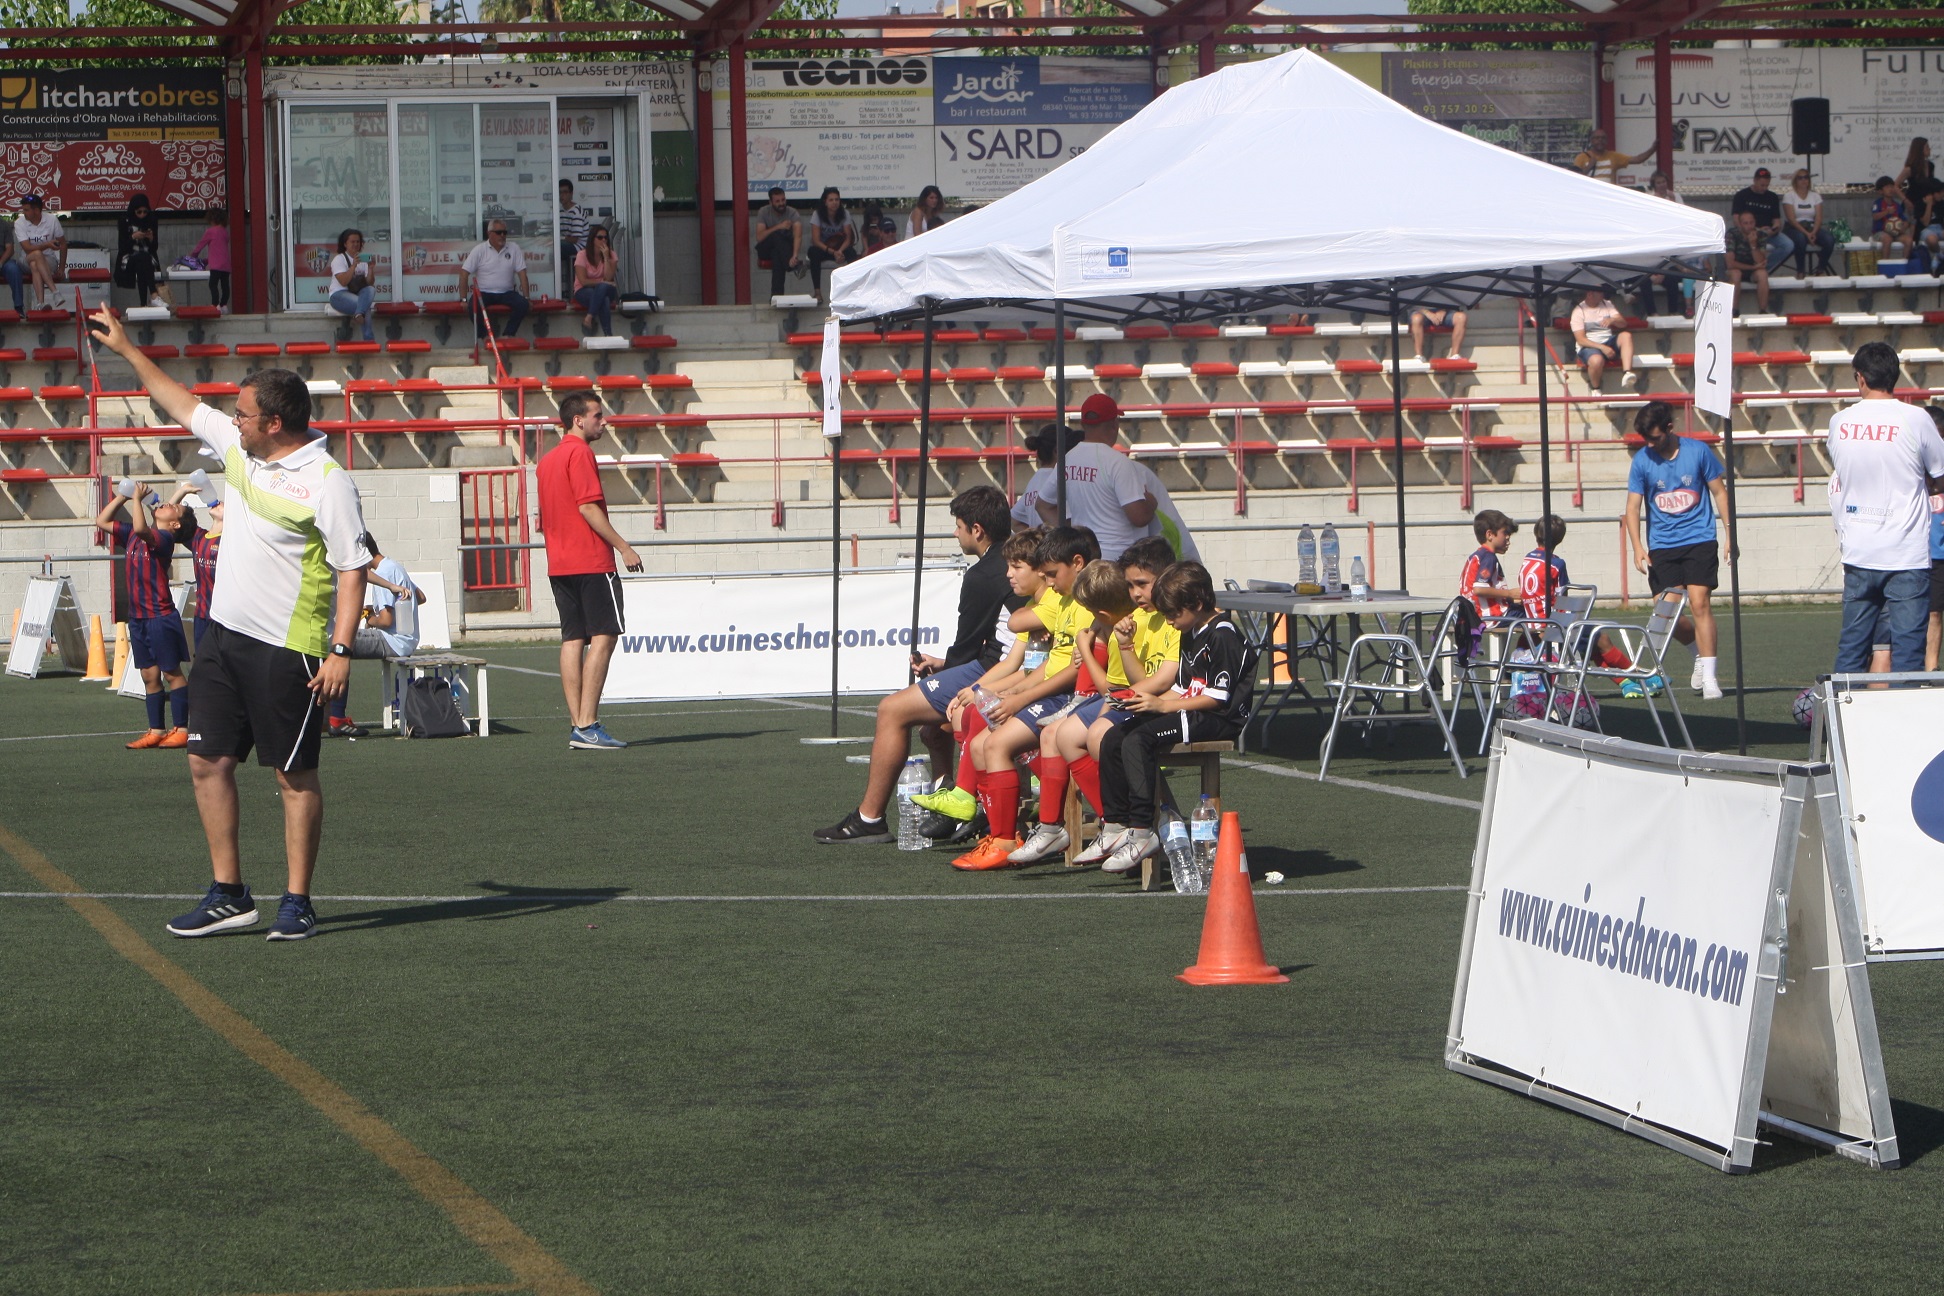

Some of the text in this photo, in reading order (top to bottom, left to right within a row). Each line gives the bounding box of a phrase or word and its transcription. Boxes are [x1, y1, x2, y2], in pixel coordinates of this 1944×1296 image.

[533, 66, 685, 76] TOTA CLASSE DE TREBALLS
[716, 74, 766, 88] esola
[1411, 73, 1463, 89] Energia
[1467, 72, 1505, 85] Solar
[43, 83, 219, 108] itchartobres
[650, 94, 686, 105] ARREC
[745, 90, 917, 98] cnos@hotmail.com www.autoescuela-tecnos.com
[950, 107, 967, 117] bar
[976, 107, 1027, 116] restaurant
[1423, 105, 1436, 114] 93
[1441, 105, 1460, 114] 757
[1464, 104, 1478, 114] 30
[1482, 104, 1495, 114] 25
[2, 114, 70, 124] Construccions
[72, 114, 106, 124] d'Obra
[110, 114, 135, 122] Nova
[144, 112, 220, 122] Rehabilitacions.
[1899, 117, 1944, 125] VETERIN
[538, 118, 549, 136] DE
[1461, 122, 1520, 144] Muguet
[860, 132, 871, 140] Tot
[872, 132, 886, 140] per
[887, 132, 894, 140] al
[785, 155, 808, 178] bu
[28, 234, 50, 242] HKT
[524, 252, 546, 261] Mar
[1702, 298, 1722, 314] CAMPO
[1706, 342, 1717, 385] 2
[1839, 422, 1900, 443] STAFF
[1064, 465, 1098, 483] STAFF
[285, 484, 304, 496] DANI
[1658, 494, 1690, 508] DANI
[622, 622, 940, 654] www.cuineschacon.com
[1498, 882, 1749, 1006] www.cuineschacon.com
